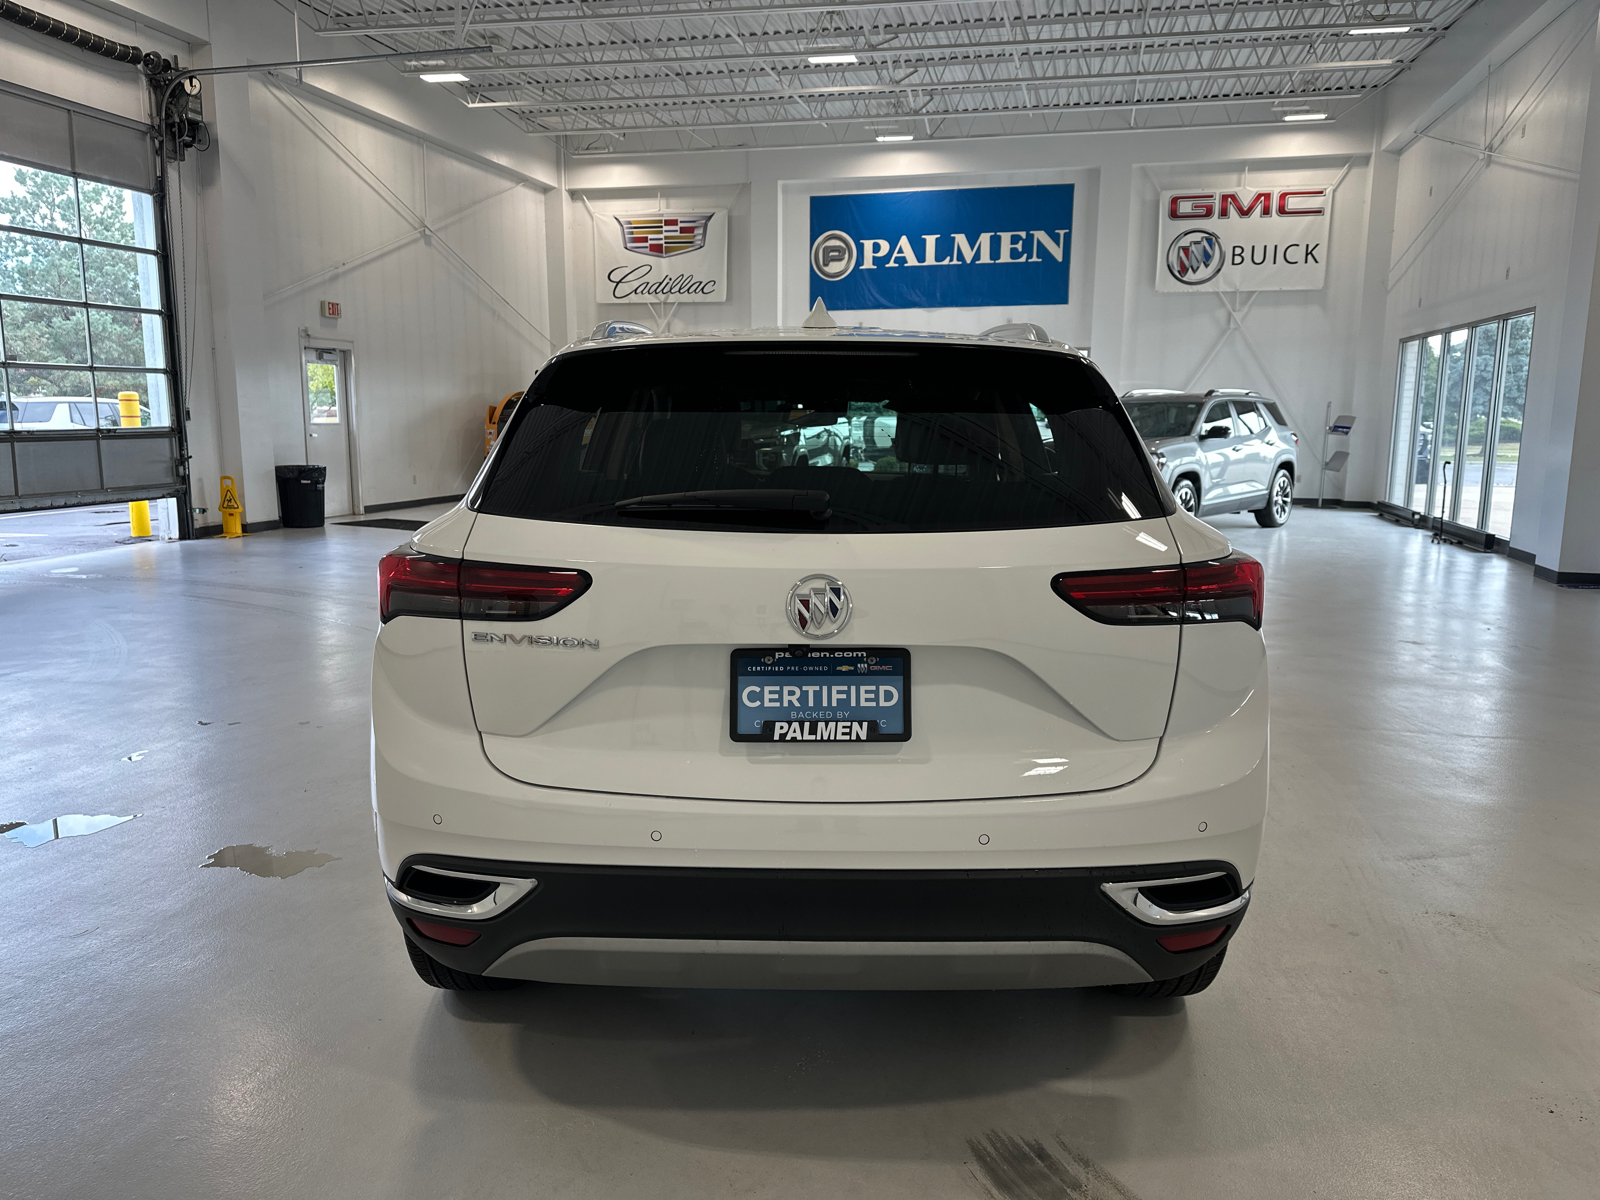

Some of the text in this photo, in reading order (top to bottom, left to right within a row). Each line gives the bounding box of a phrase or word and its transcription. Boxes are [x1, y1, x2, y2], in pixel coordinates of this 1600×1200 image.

[1168, 188, 1327, 221] GMC
[859, 229, 1070, 269] PALMEN
[1231, 243, 1320, 266] BUICK
[607, 264, 717, 299] Cadillac
[327, 301, 340, 317] EXIT
[471, 631, 600, 650] ENVISION
[775, 651, 867, 659] paen.com
[741, 685, 899, 708] CERTIFIED
[790, 711, 850, 719] BACKED BY
[773, 721, 868, 741] PALMEN
